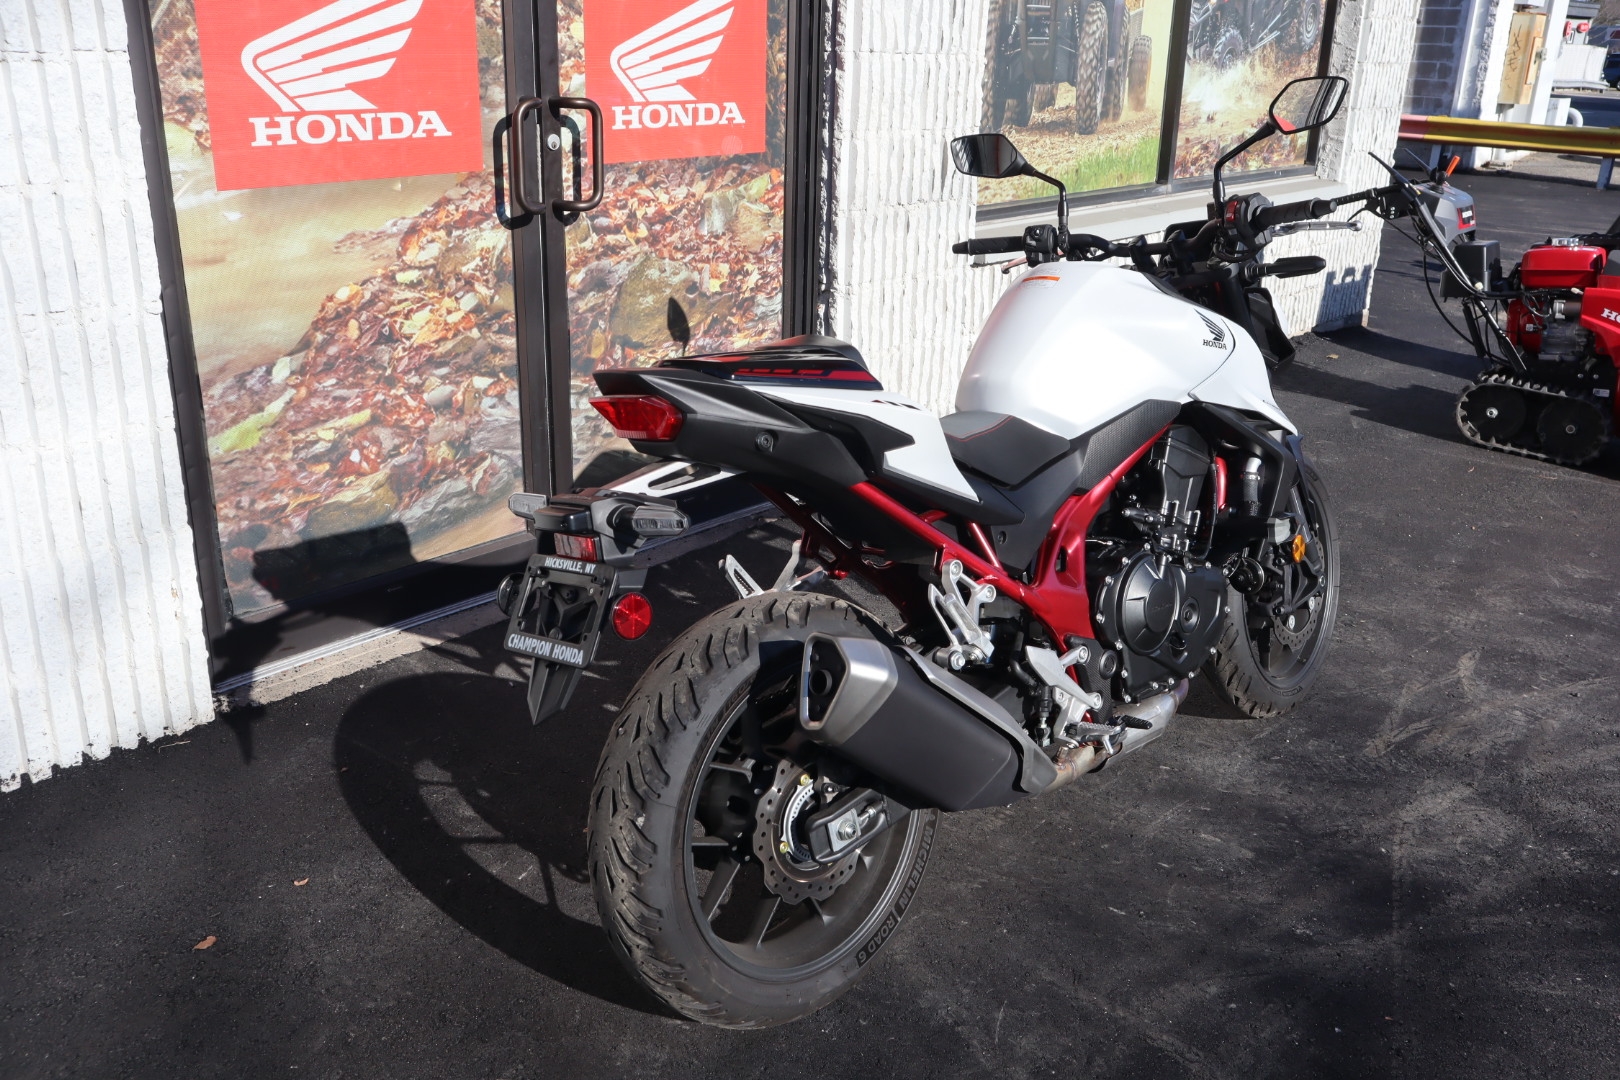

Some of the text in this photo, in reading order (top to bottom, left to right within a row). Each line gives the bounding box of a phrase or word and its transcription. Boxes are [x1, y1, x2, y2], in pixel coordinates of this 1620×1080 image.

[248, 110, 453, 147] HONDA
[611, 101, 746, 130] HONDA
[1202, 338, 1228, 351] HONDA
[544, 557, 597, 575] HICKSVILLE, NY
[507, 633, 584, 665] CHAMPION HONDA
[899, 827, 933, 910] MICHELIN
[867, 915, 895, 952] ROAD
